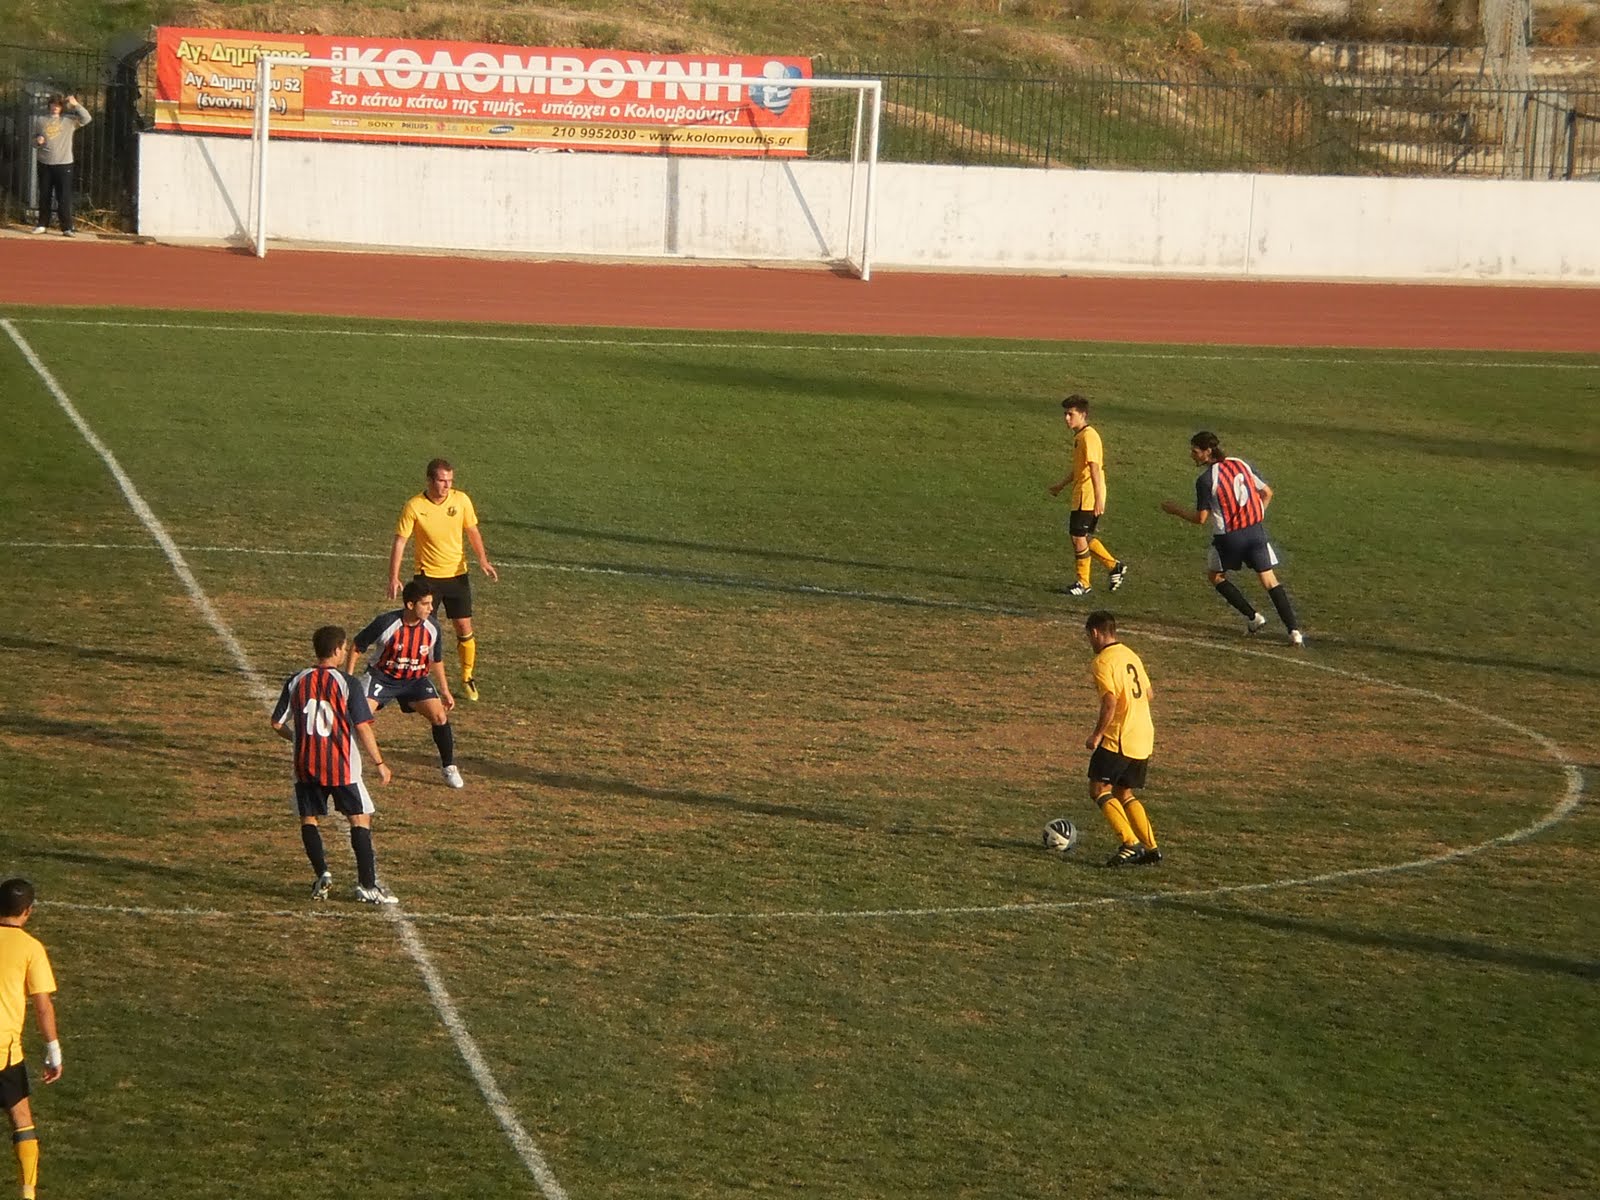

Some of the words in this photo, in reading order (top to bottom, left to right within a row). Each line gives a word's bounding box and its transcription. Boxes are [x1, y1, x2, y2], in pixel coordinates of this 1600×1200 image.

[177, 40, 207, 64] Αγ.
[184, 72, 207, 89] Αγ.
[210, 73, 280, 92] Δημητρυ
[284, 78, 301, 92] 52
[345, 47, 742, 102] ΚΟΛΟΜΒΟΥΝΗ
[329, 90, 357, 106] Στο
[361, 92, 402, 108] κάτω
[406, 94, 447, 110] κάτω
[452, 99, 479, 114] της
[482, 99, 536, 116] τιμής...
[541, 101, 605, 119] υπάρχει
[609, 106, 620, 117] ο
[624, 103, 740, 124] Κολομβούνης!
[367, 121, 395, 129] SONY
[401, 122, 429, 130] PHILIPS
[552, 126, 576, 138] 210
[580, 127, 637, 140] 9952030
[649, 131, 793, 147] www.kolomvounis.gr
[1233, 472, 1249, 507] 6
[373, 683, 384, 697] 7
[1126, 663, 1142, 699] 3
[303, 698, 335, 737] 10
